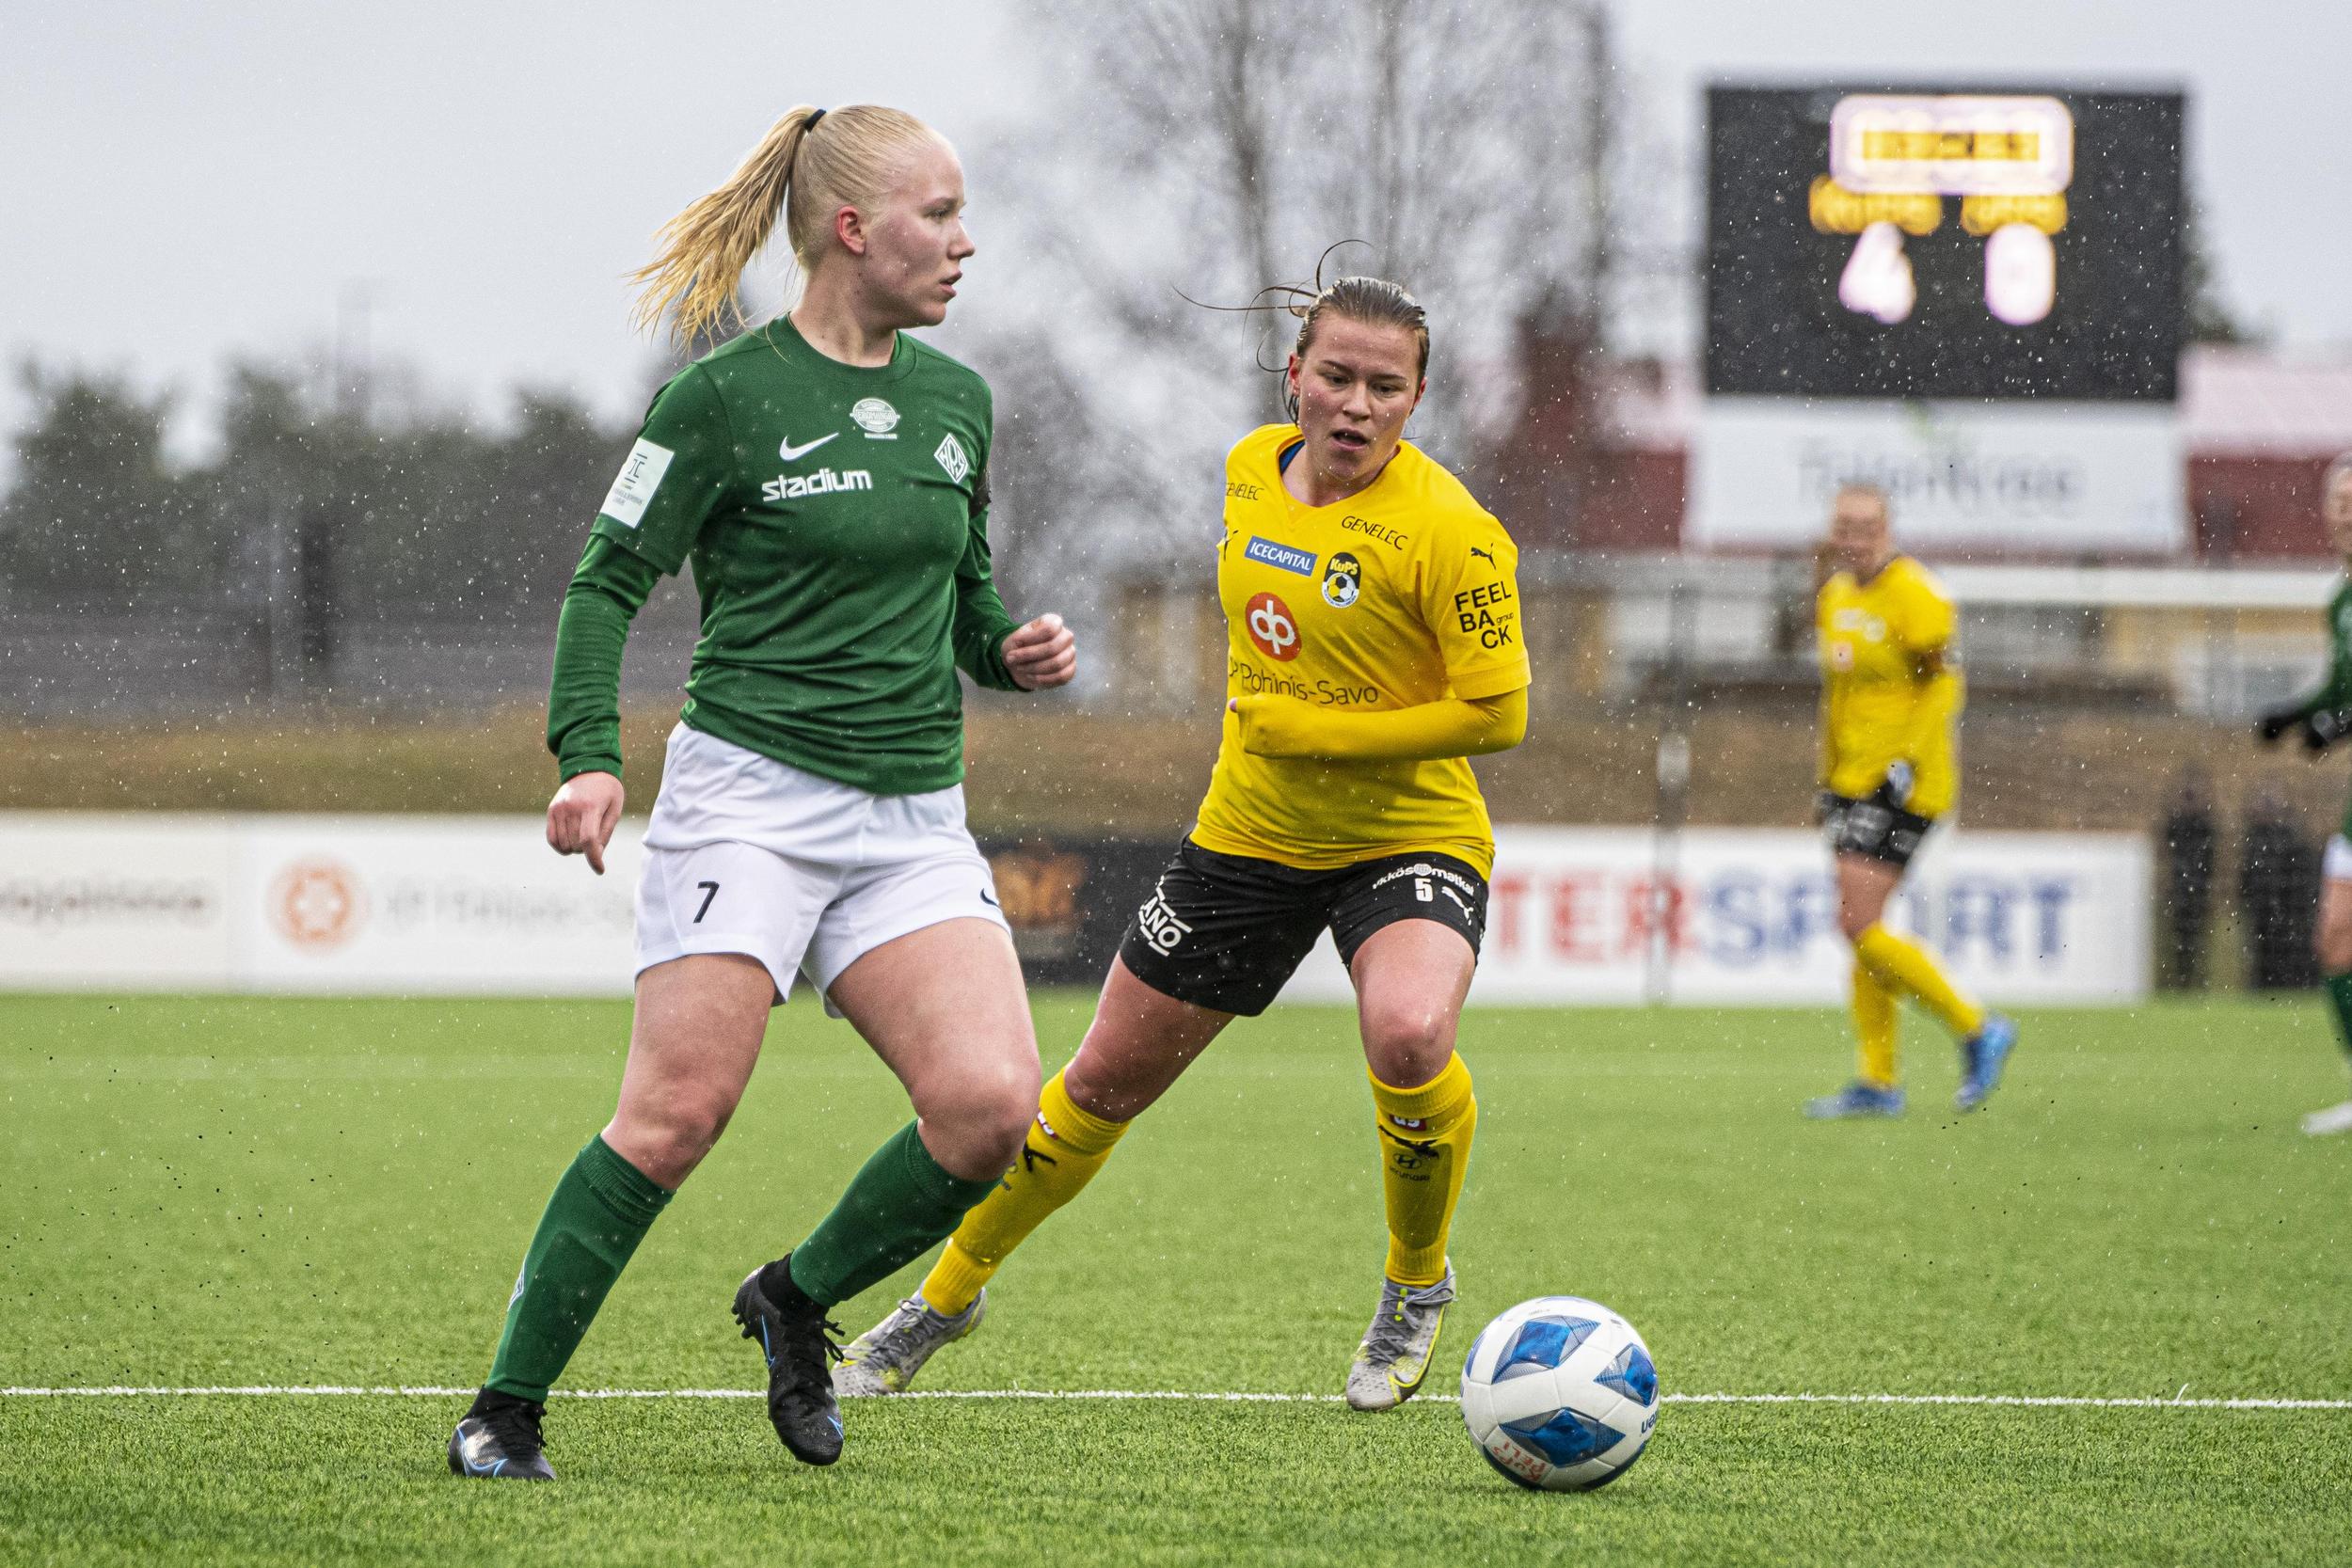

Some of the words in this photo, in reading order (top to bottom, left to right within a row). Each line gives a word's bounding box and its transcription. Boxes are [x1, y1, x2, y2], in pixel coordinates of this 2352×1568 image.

[761, 467, 873, 502] stadium
[1226, 482, 1264, 501] ENELEC
[1341, 515, 1408, 550] GENELEC
[1249, 542, 1311, 571] ICECAPITAL
[1329, 558, 1359, 575] KuPS
[1454, 580, 1512, 612] FEEL
[1459, 609, 1496, 633] BA
[1481, 624, 1513, 649] CK
[692, 880, 720, 924] 7
[1414, 878, 1434, 902] 5
[1489, 870, 2077, 959] TERSPRT
